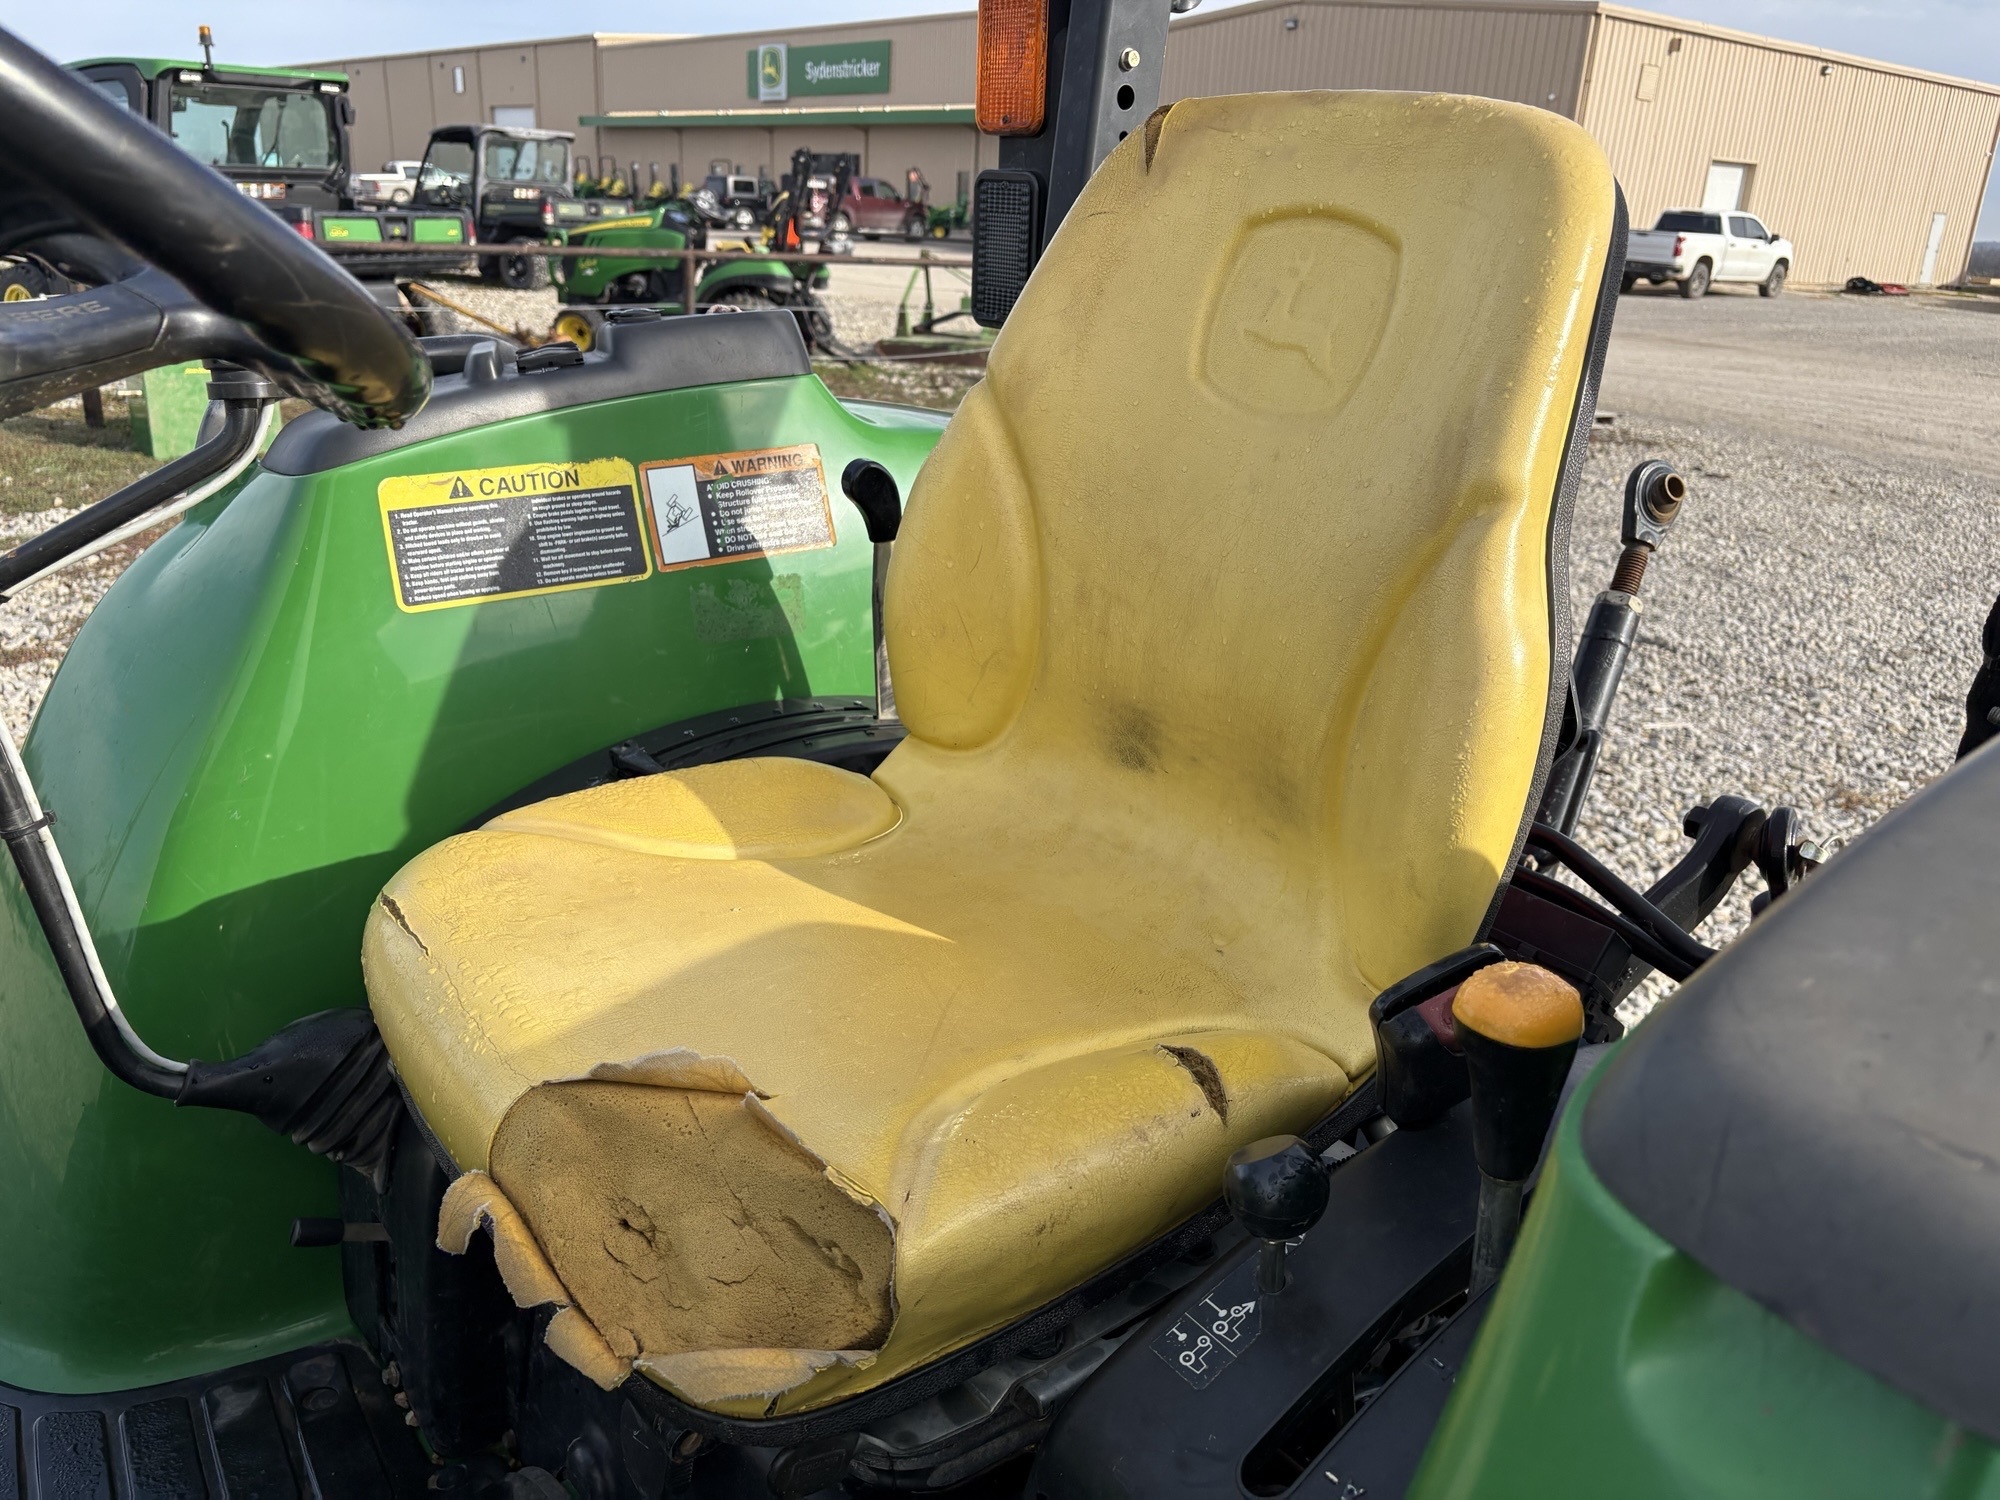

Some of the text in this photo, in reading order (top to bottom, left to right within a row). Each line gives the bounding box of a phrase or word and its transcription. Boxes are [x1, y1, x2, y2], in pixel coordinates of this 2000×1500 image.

[805, 58, 881, 84] Sydenstricker
[731, 454, 803, 475] WARNING
[480, 469, 579, 496] CAUTION
[706, 482, 729, 491] AOID
[716, 491, 734, 500] Keep
[736, 487, 764, 497] Rollover
[469, 504, 490, 512] operating
[718, 498, 751, 509] Structure
[418, 525, 436, 533] operate
[725, 536, 737, 544] DO
[737, 533, 753, 542] NOT
[727, 544, 746, 552] Drive
